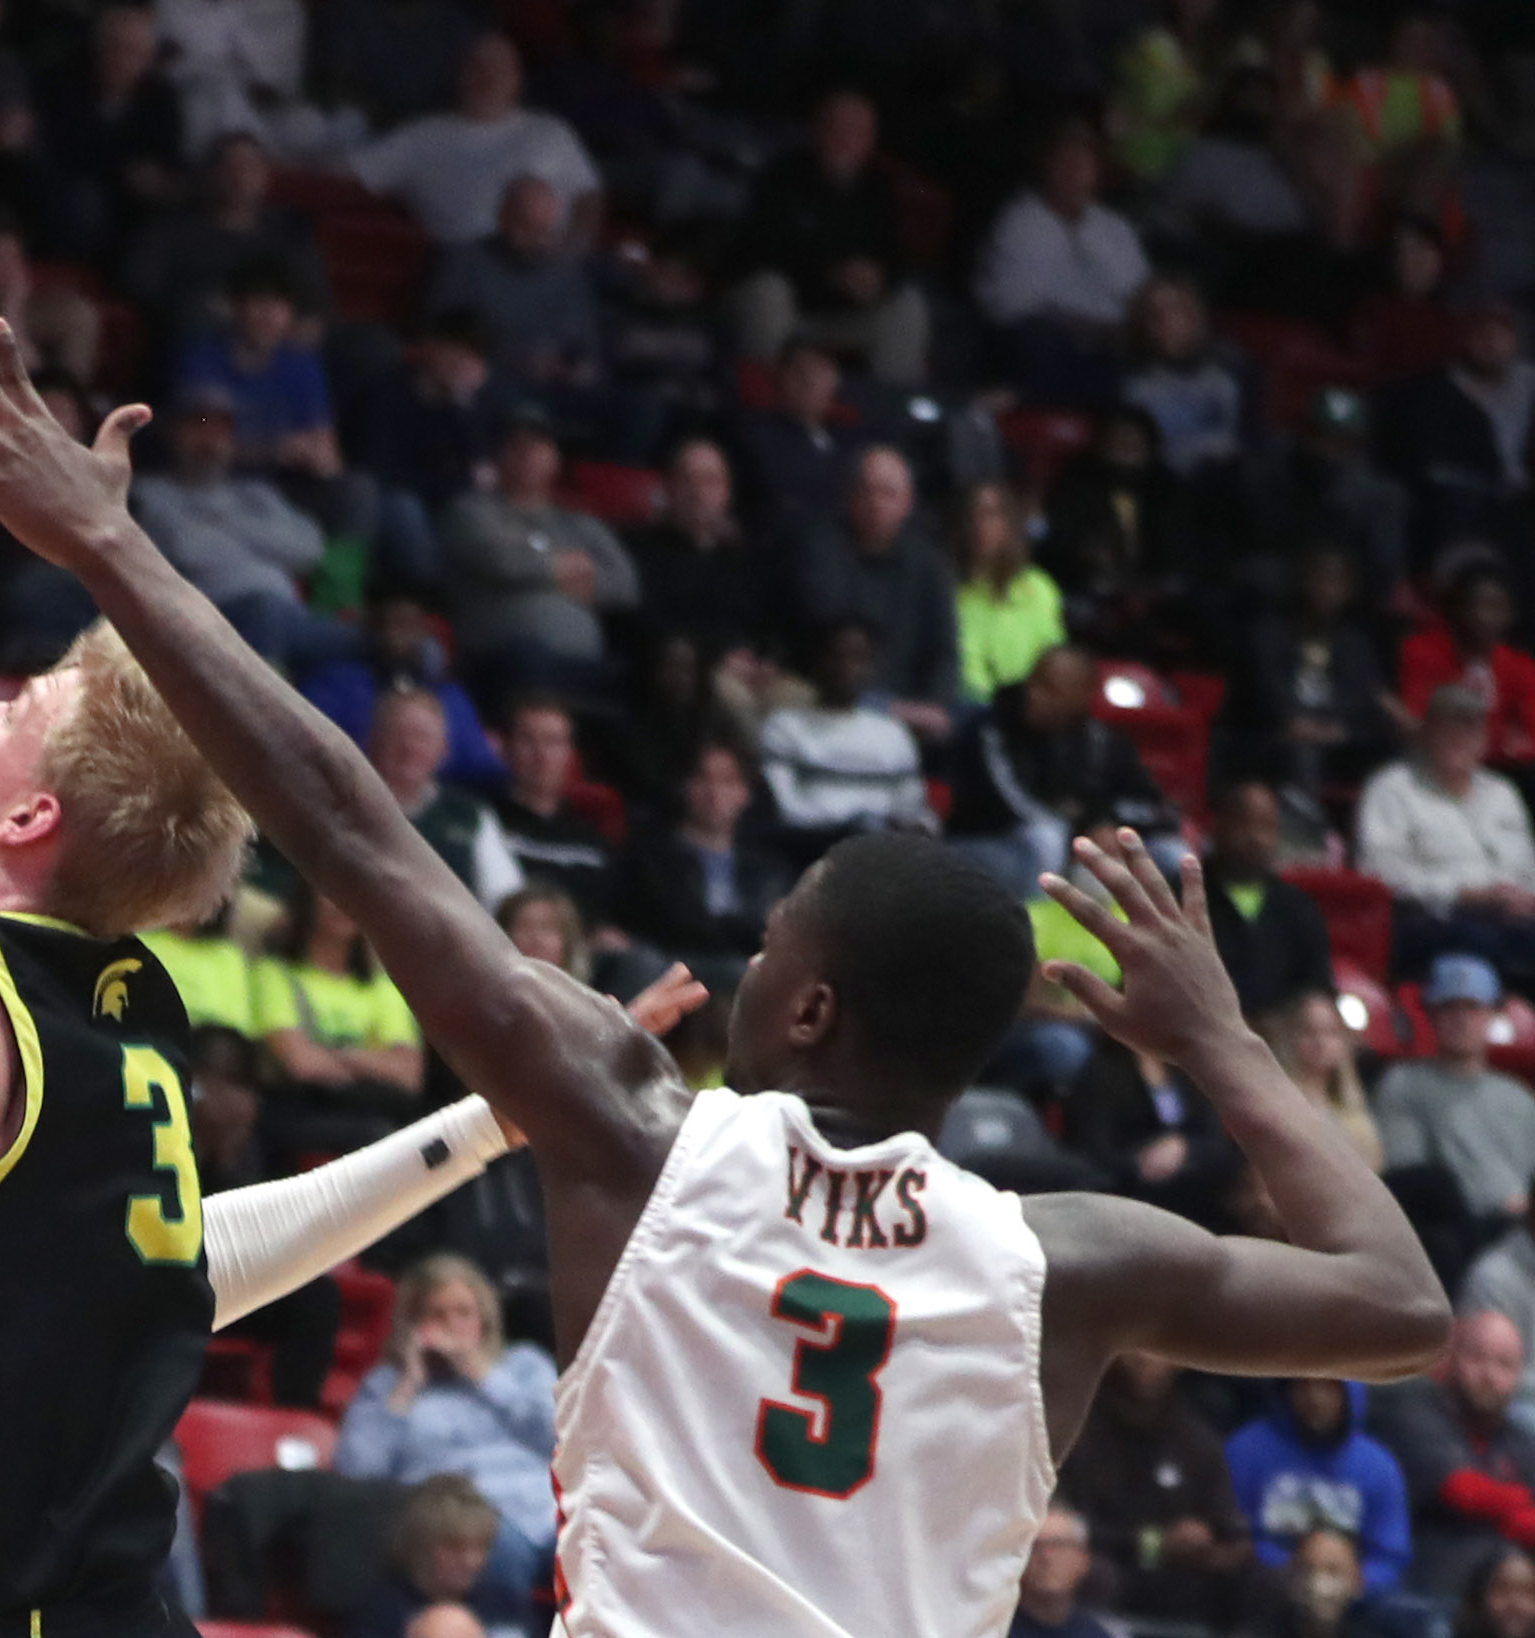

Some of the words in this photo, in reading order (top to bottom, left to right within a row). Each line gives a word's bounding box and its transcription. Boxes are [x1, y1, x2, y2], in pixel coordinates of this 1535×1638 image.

[120, 1042, 204, 1267] 3
[785, 1146, 927, 1249] VIKS
[754, 1267, 898, 1501] 3
